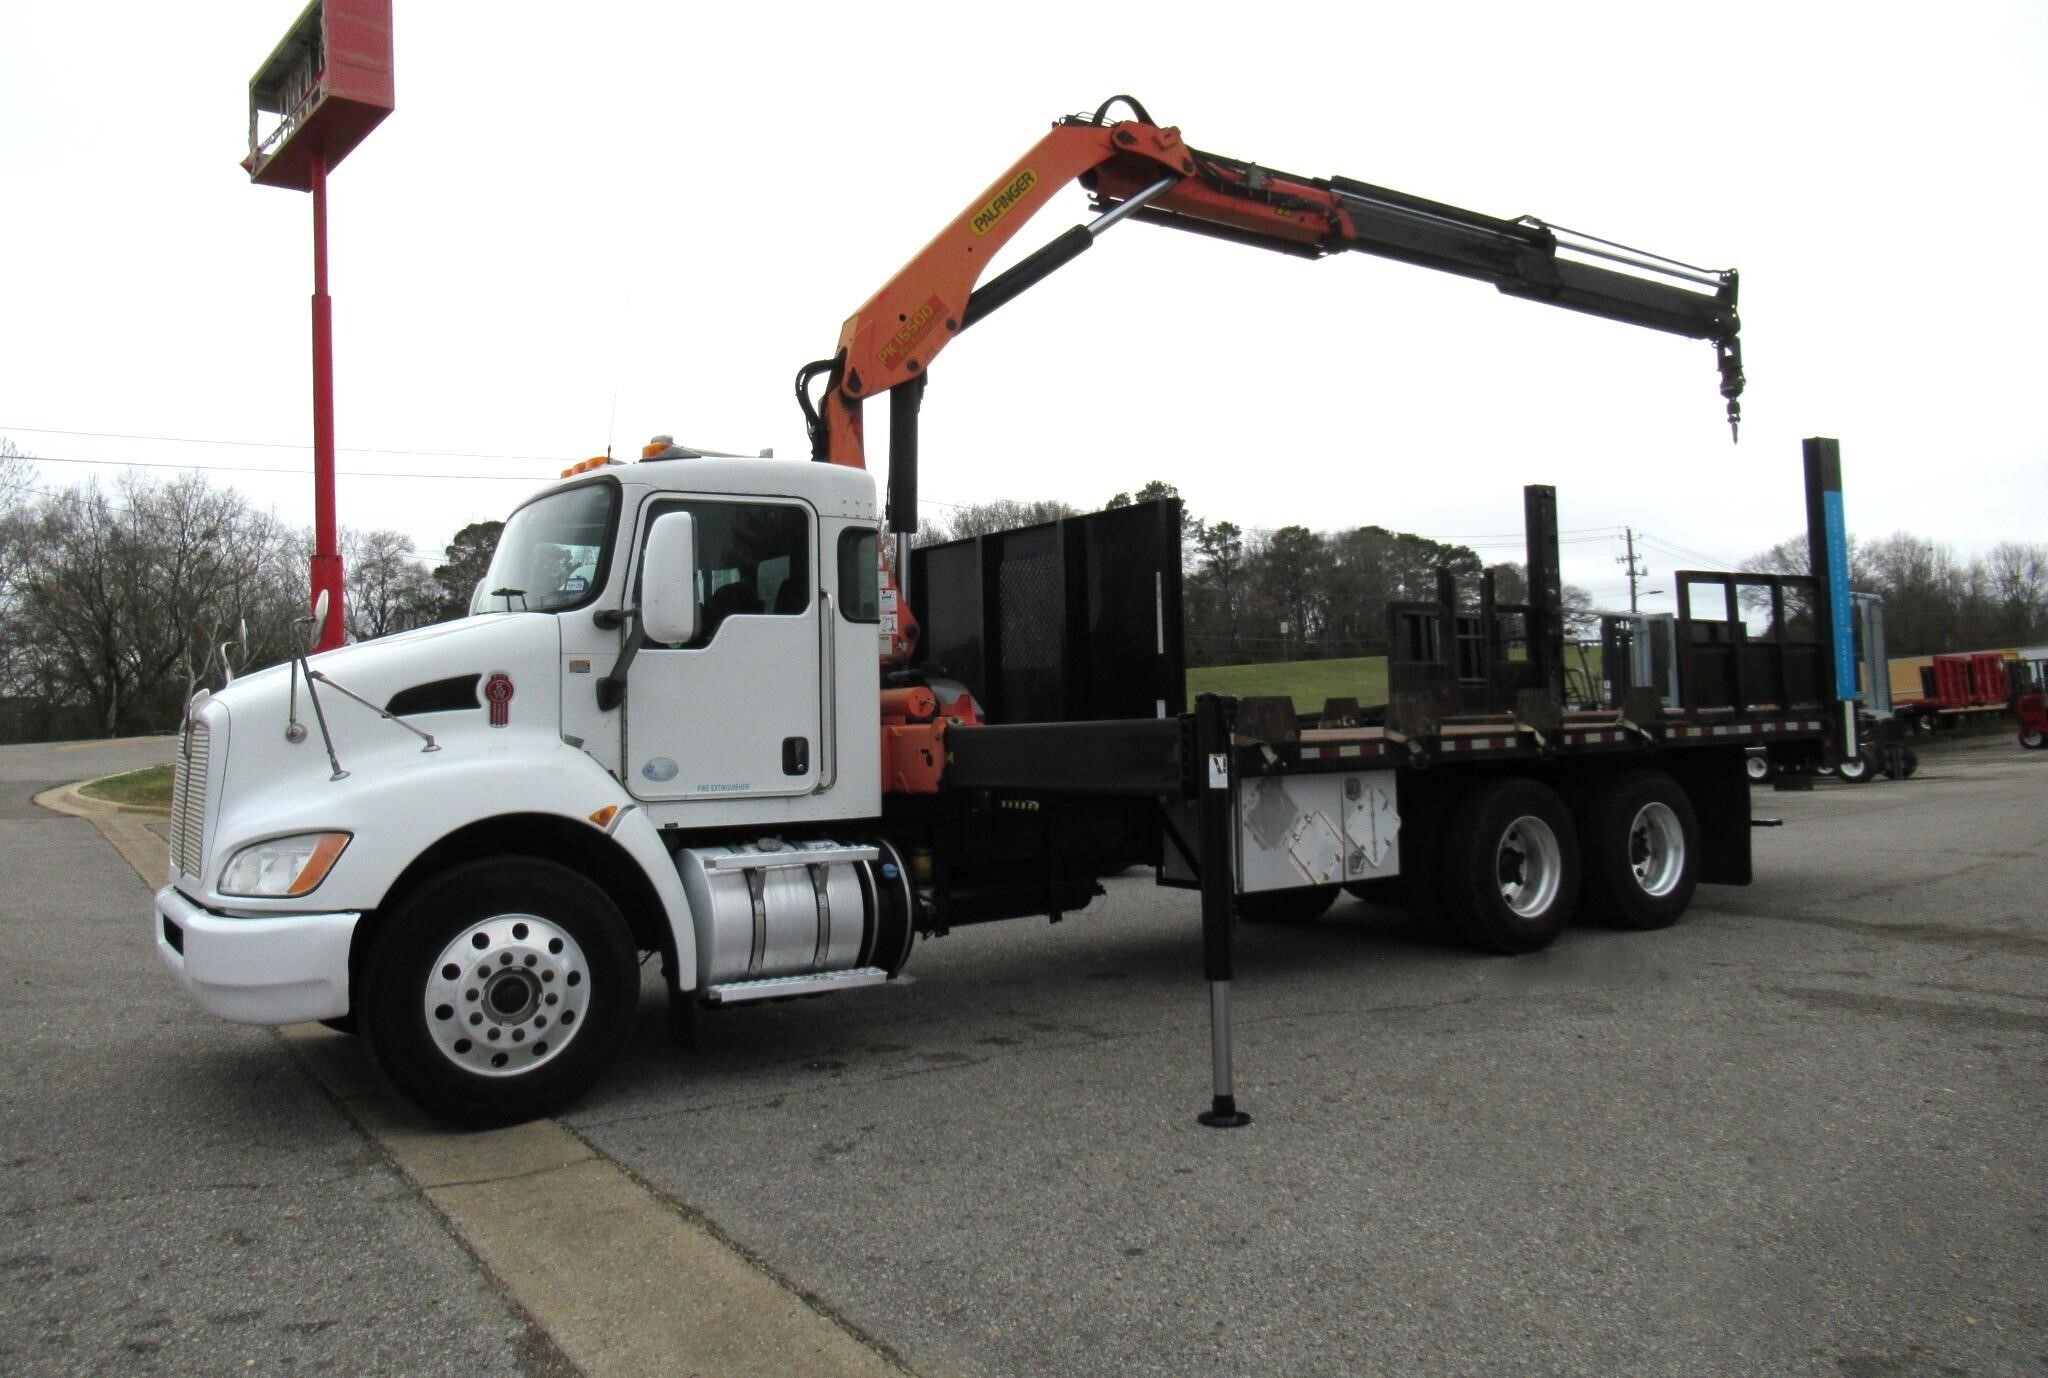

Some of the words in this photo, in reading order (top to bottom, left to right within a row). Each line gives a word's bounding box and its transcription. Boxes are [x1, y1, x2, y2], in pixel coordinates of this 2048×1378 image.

[974, 171, 1036, 232] PALFINGER
[878, 342, 897, 366] PK
[895, 304, 934, 345] 15500
